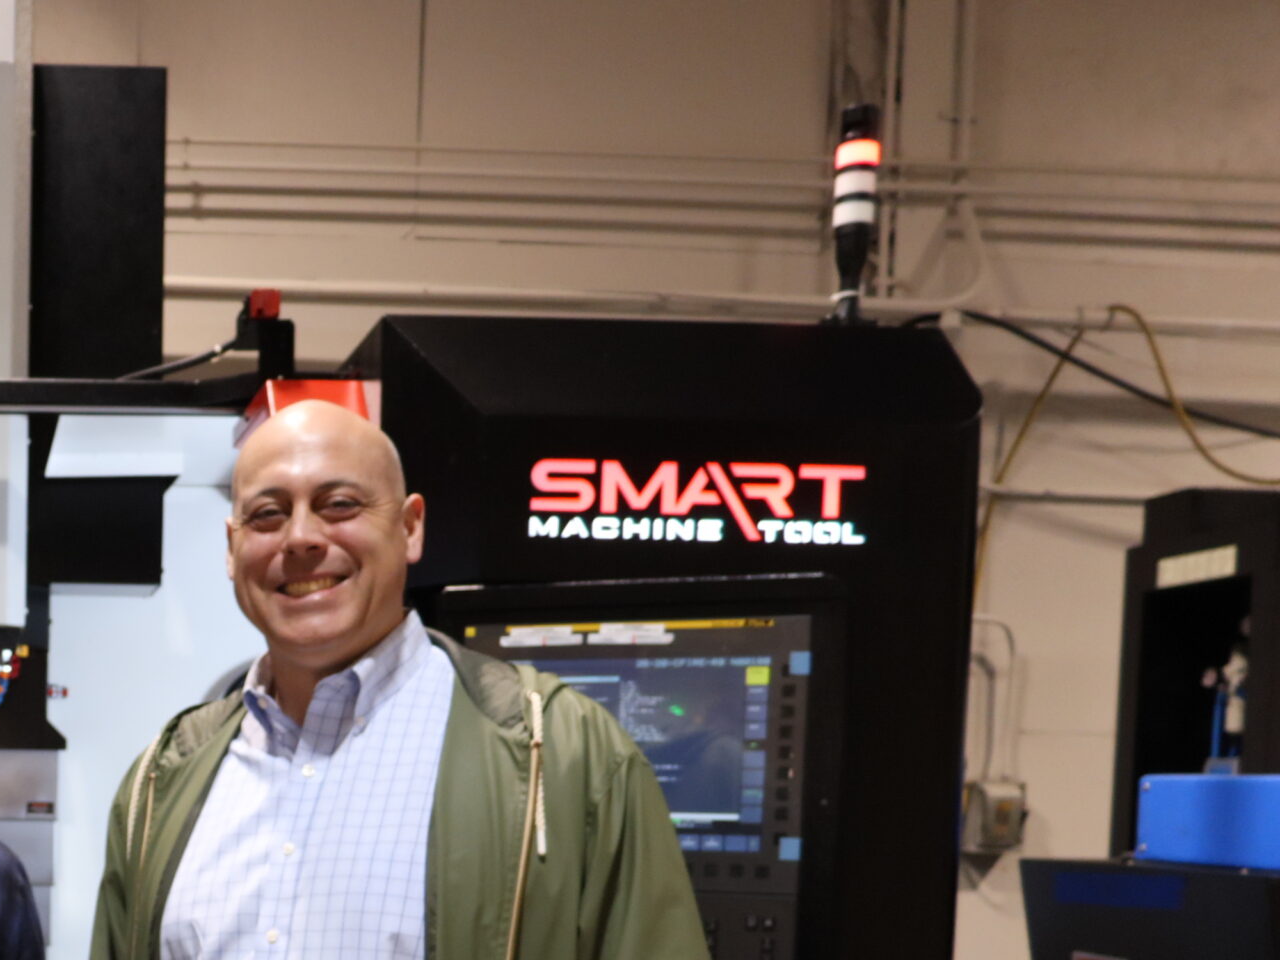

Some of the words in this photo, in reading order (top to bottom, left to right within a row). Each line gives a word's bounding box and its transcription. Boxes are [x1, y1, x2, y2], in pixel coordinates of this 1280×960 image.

[529, 457, 867, 526] SMART
[528, 515, 724, 542] MACHINE
[756, 519, 867, 545] TOOL
